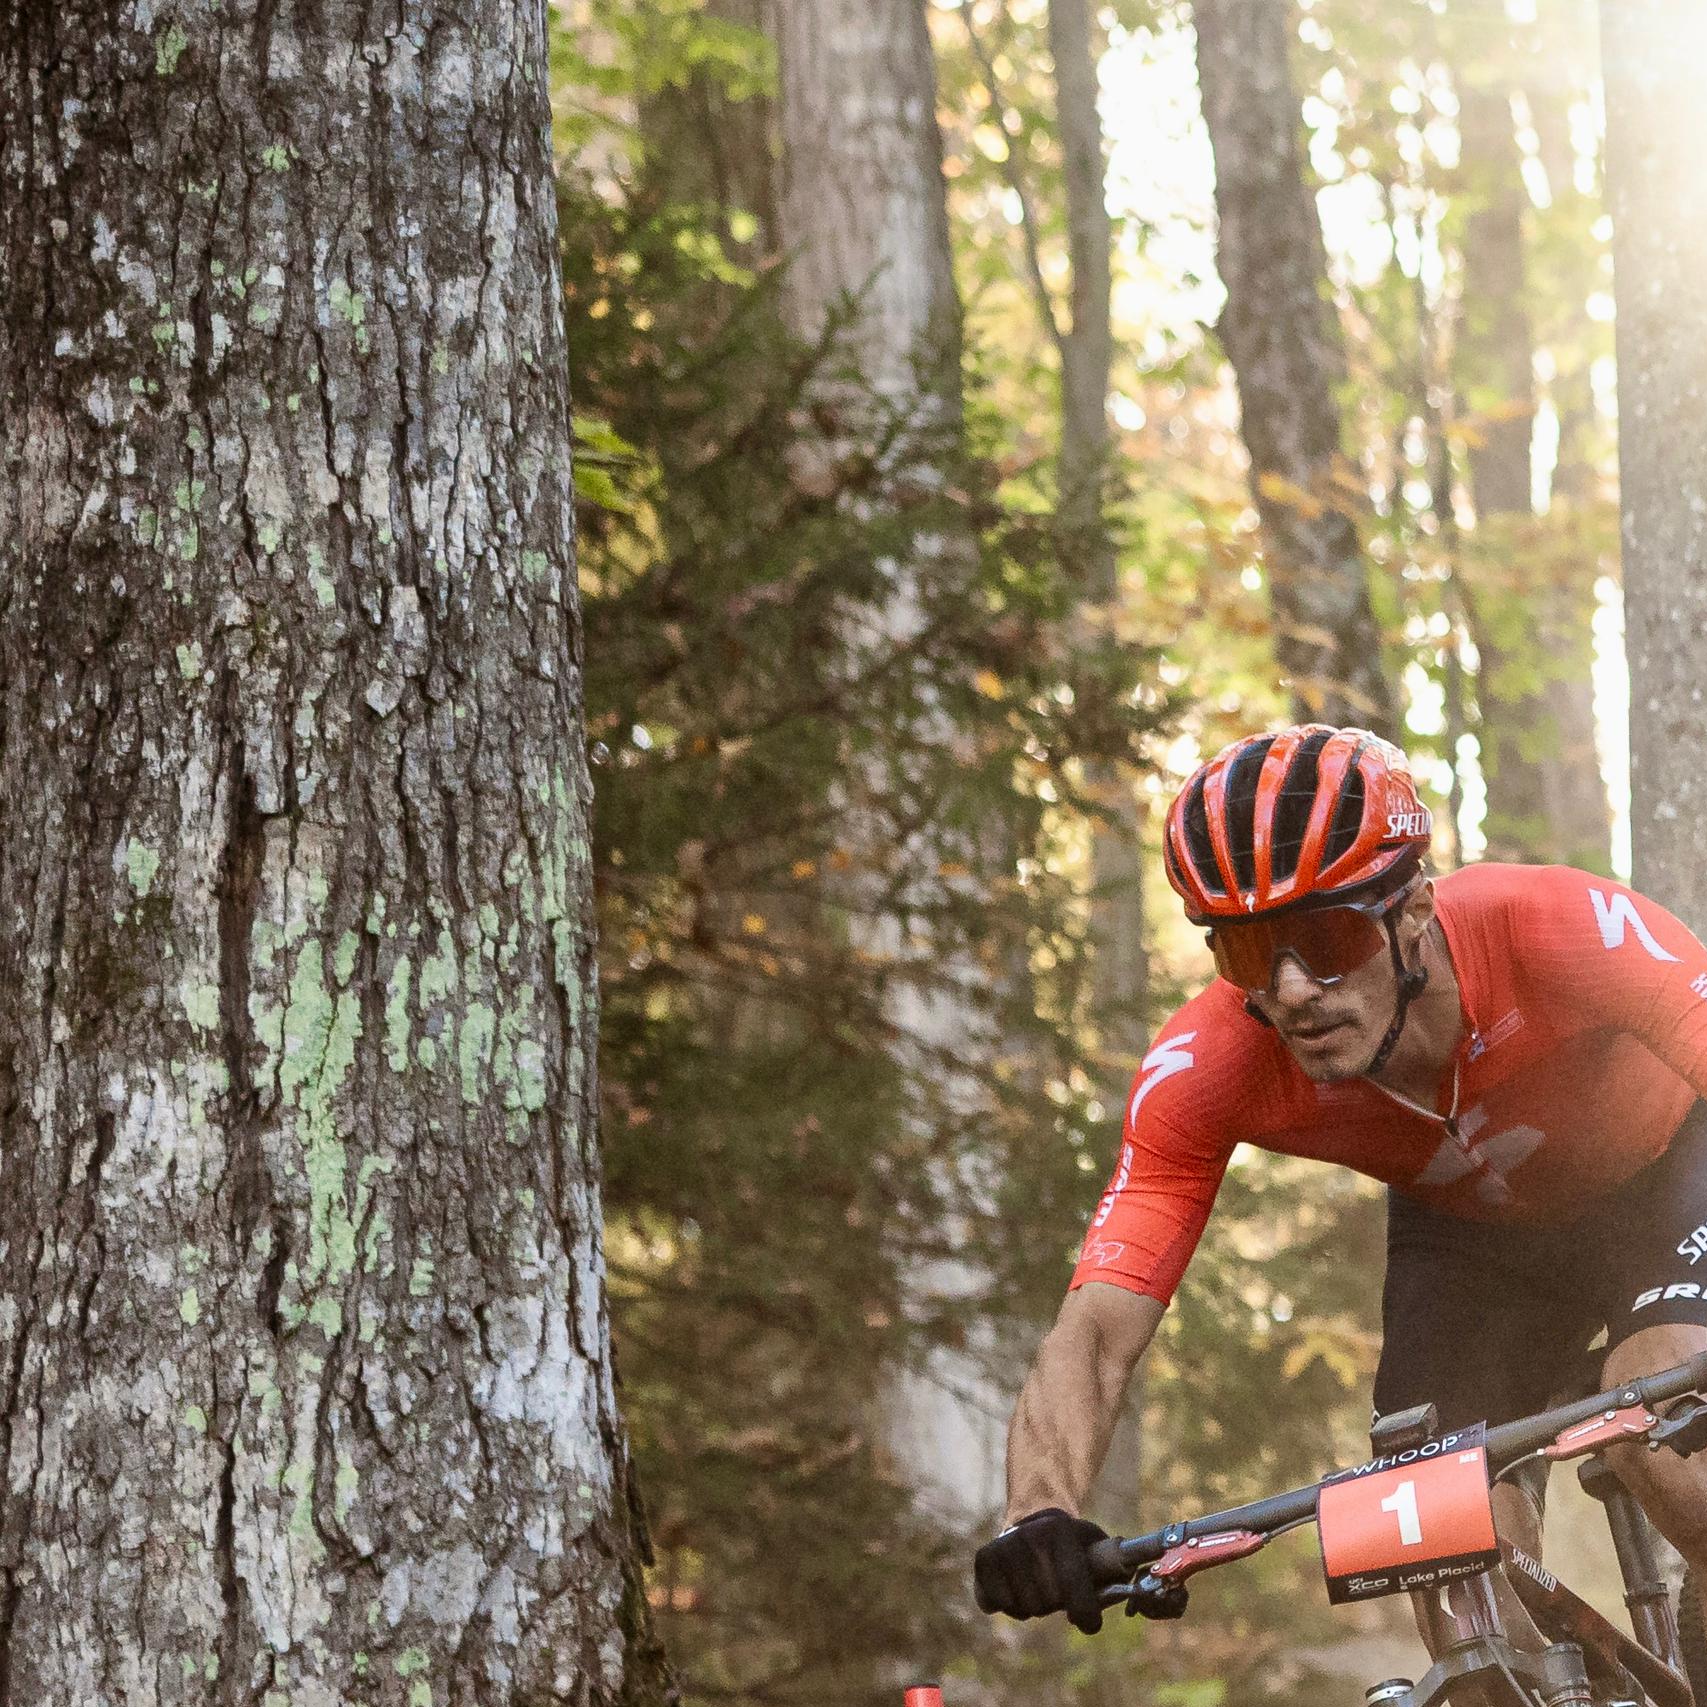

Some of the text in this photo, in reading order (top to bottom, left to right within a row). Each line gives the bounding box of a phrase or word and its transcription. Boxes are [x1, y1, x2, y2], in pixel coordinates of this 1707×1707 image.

[1352, 1435, 1459, 1477] WHOOP
[1381, 1480, 1423, 1546] 1
[1399, 1561, 1485, 1586] Lake Placid
